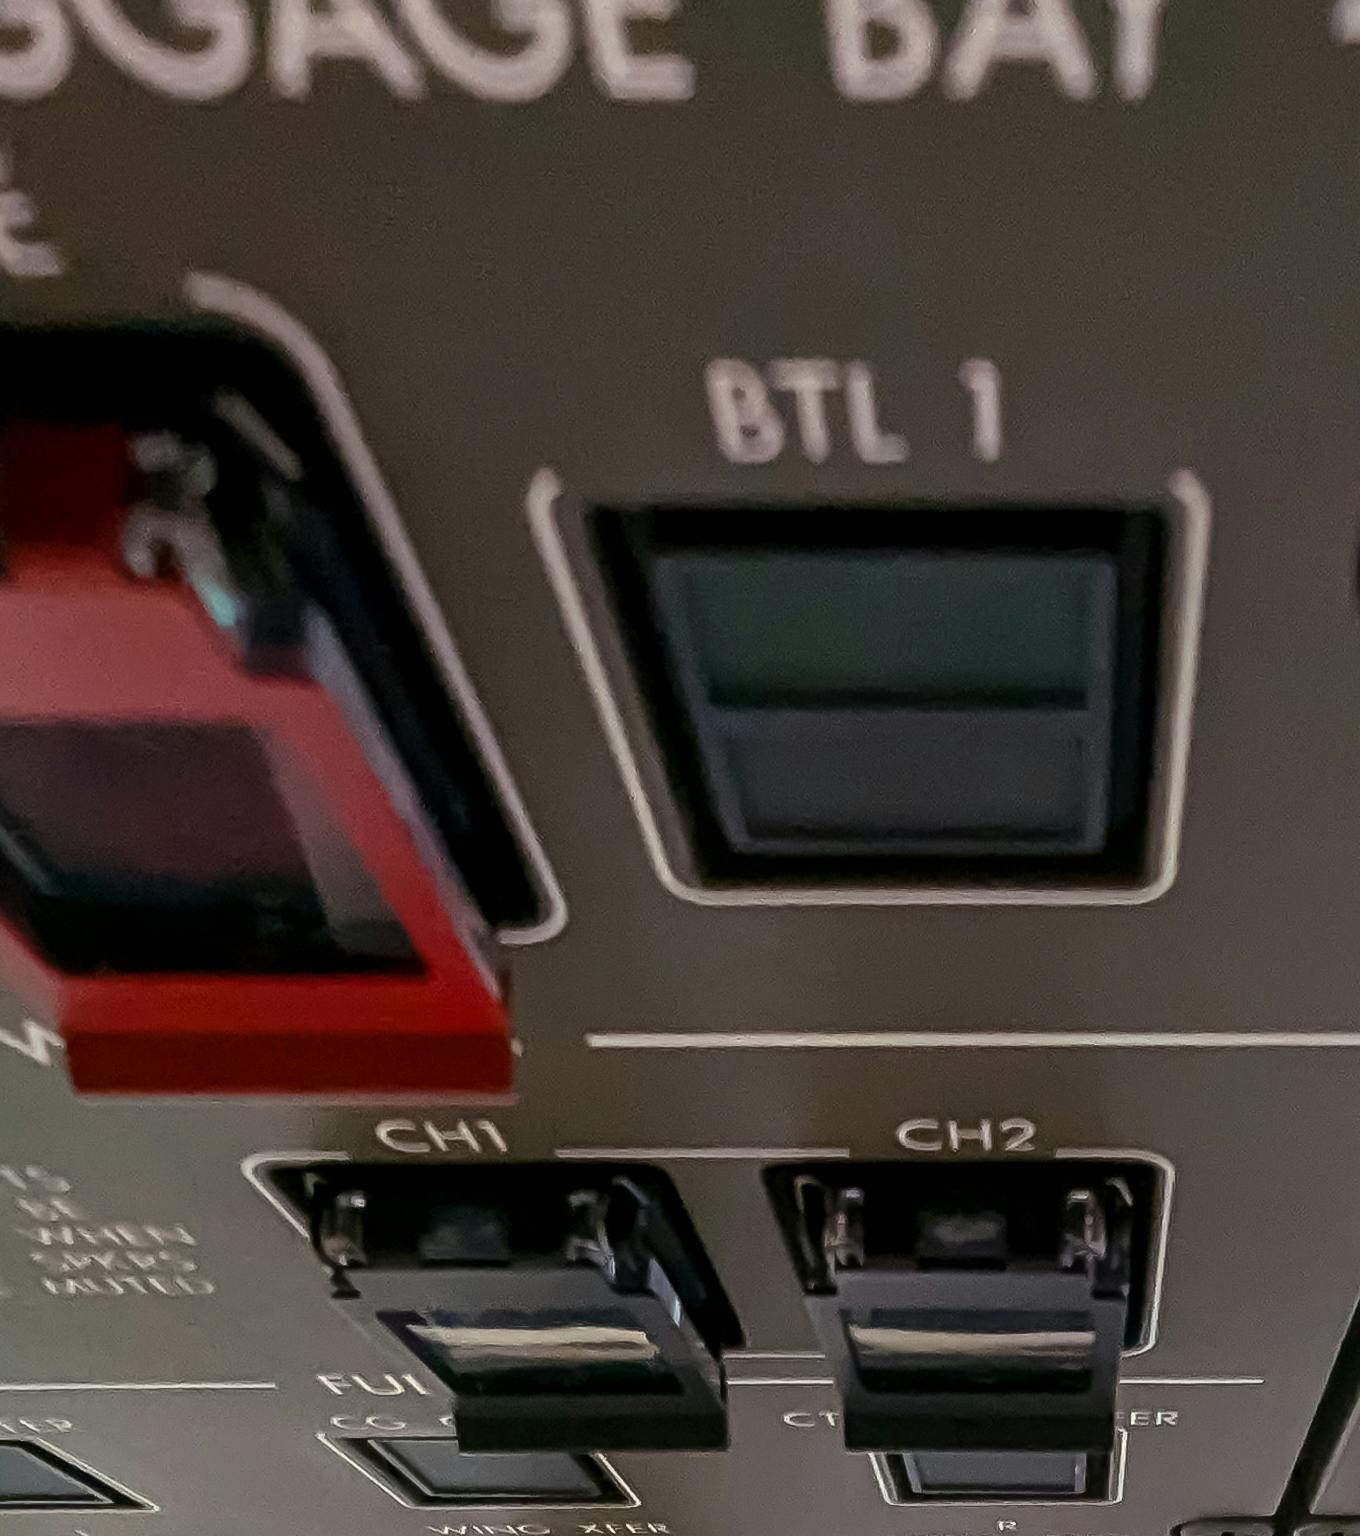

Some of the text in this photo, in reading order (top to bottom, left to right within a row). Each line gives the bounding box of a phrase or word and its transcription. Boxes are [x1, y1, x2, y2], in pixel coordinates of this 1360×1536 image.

[704, 355, 1003, 465] BTL 1
[375, 1118, 511, 1155] CH1
[894, 1118, 1040, 1153] CH2
[330, 1415, 408, 1431] CG
[424, 1522, 672, 1536] WING XFER
[997, 1519, 1018, 1532] R
